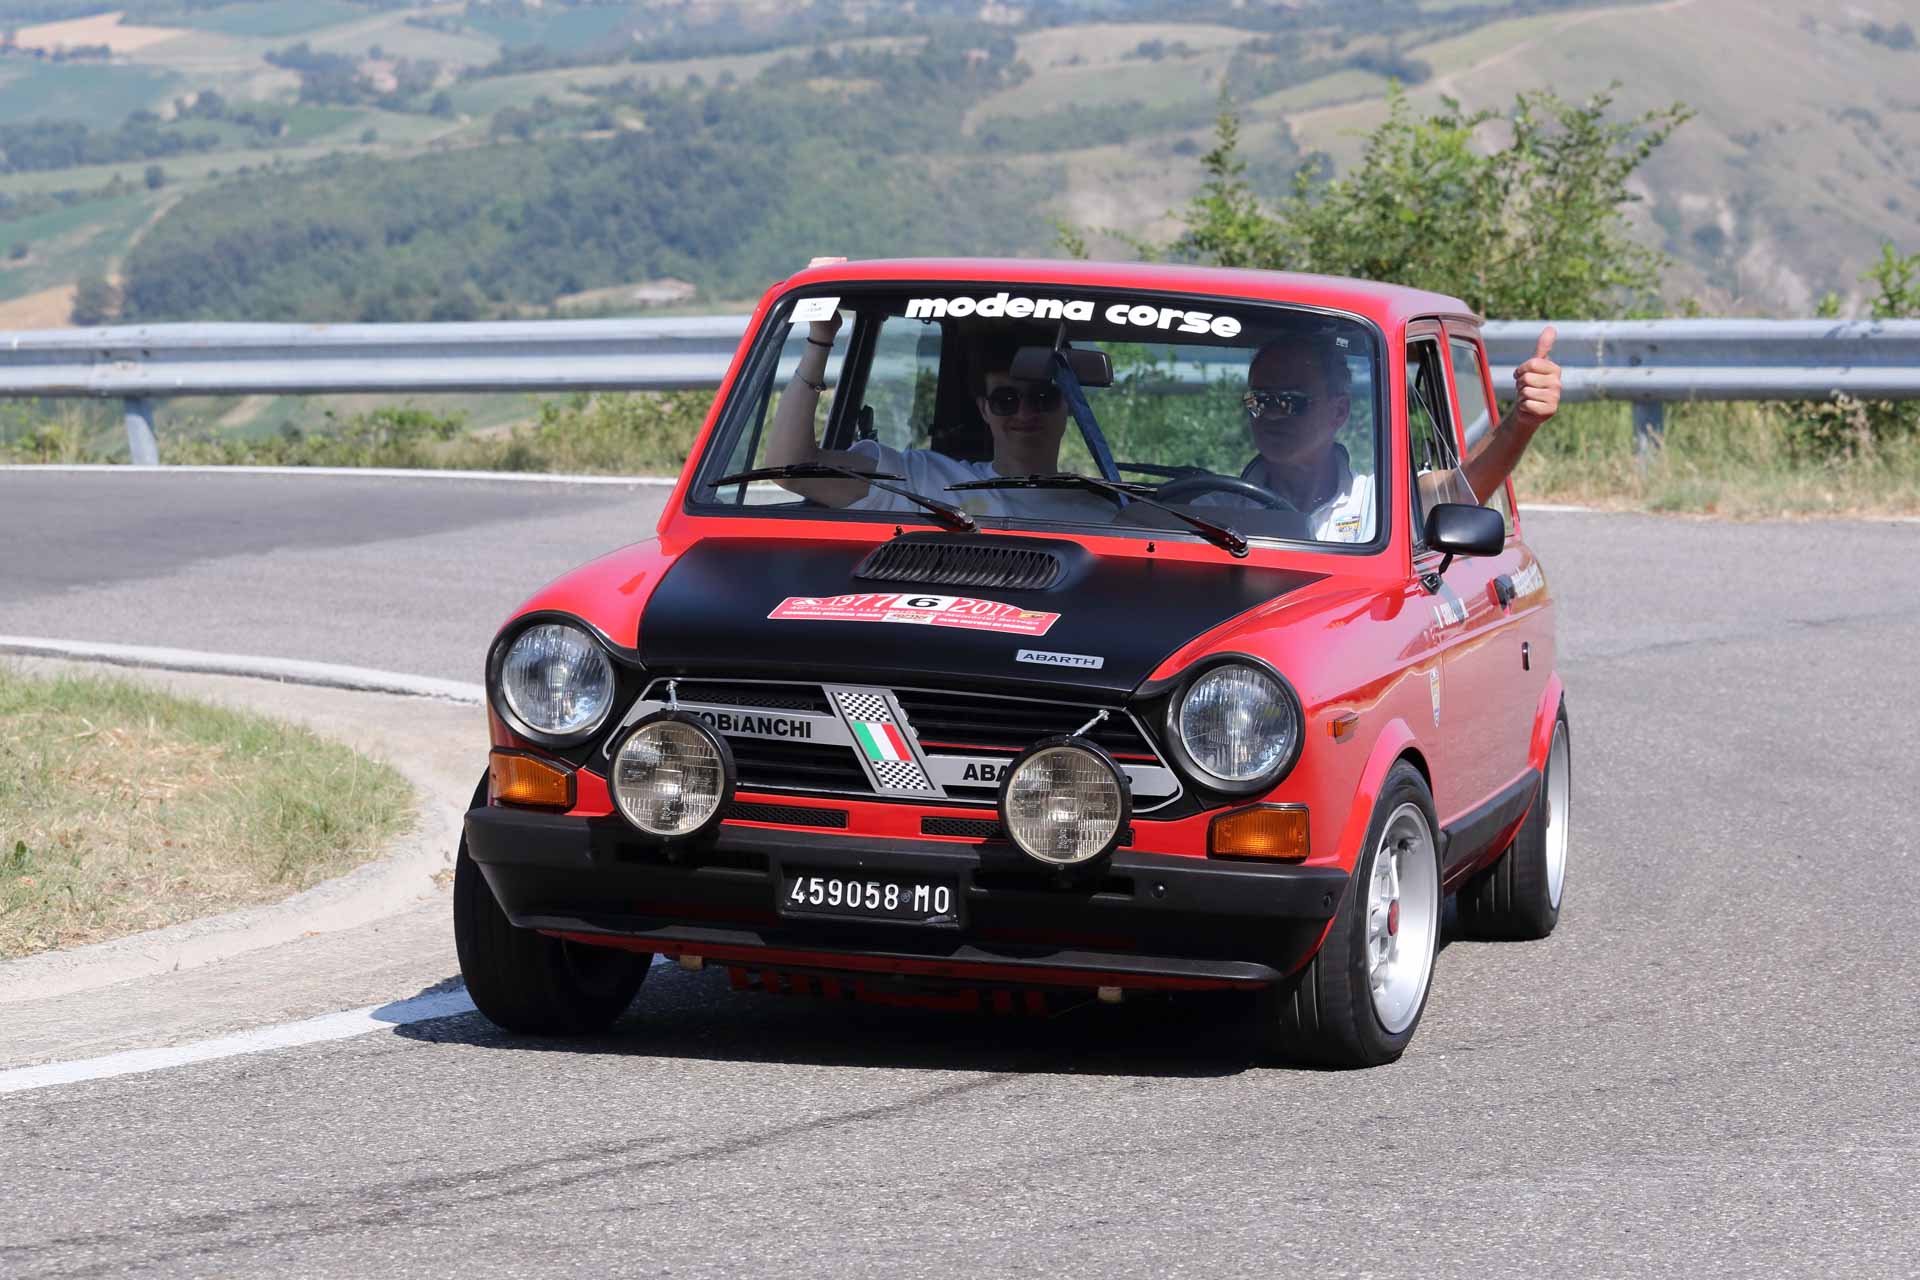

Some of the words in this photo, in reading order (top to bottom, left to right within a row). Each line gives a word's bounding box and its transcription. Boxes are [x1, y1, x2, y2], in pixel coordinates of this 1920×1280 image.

[905, 293, 1095, 321] modena
[1105, 304, 1242, 338] corse
[829, 595, 898, 608] 1977
[907, 597, 941, 608] 6
[948, 599, 1015, 616] 2017
[1023, 653, 1096, 665] ABARTH
[698, 711, 811, 738] OBiANCHI
[791, 877, 899, 911] 459058
[913, 885, 950, 913] MO
